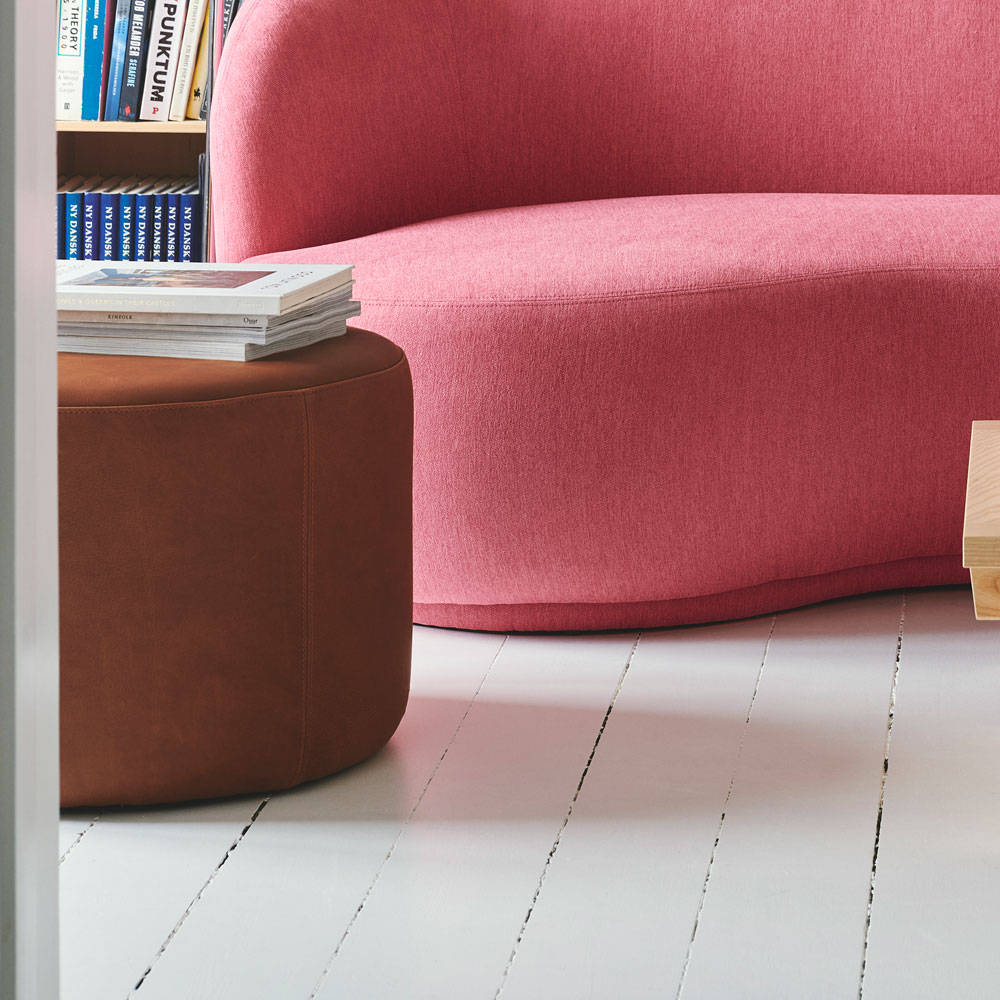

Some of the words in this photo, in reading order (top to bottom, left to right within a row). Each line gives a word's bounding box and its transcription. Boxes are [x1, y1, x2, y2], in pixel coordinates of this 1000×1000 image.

[70, 7, 80, 50] THEORY
[129, 13, 146, 56] MELANDER
[151, 2, 178, 102] PUNKTUM
[126, 58, 138, 87] SERAFINE
[69, 204, 78, 218] NY
[85, 205, 93, 219] NY
[104, 206, 113, 220] NY
[122, 206, 132, 220] NY
[138, 206, 147, 220] NY
[153, 206, 162, 220] NY
[168, 206, 177, 220] NY
[183, 207, 192, 220] NY
[68, 220, 78, 254] DANSK
[84, 221, 92, 255] DANSK
[103, 222, 113, 257] DANSK
[122, 222, 131, 257] DANSK
[137, 222, 146, 256] DANSK
[152, 222, 161, 256] DANSK
[167, 222, 176, 256] DANSK
[182, 223, 191, 257] DANSK
[108, 313, 133, 321] KINFOLK
